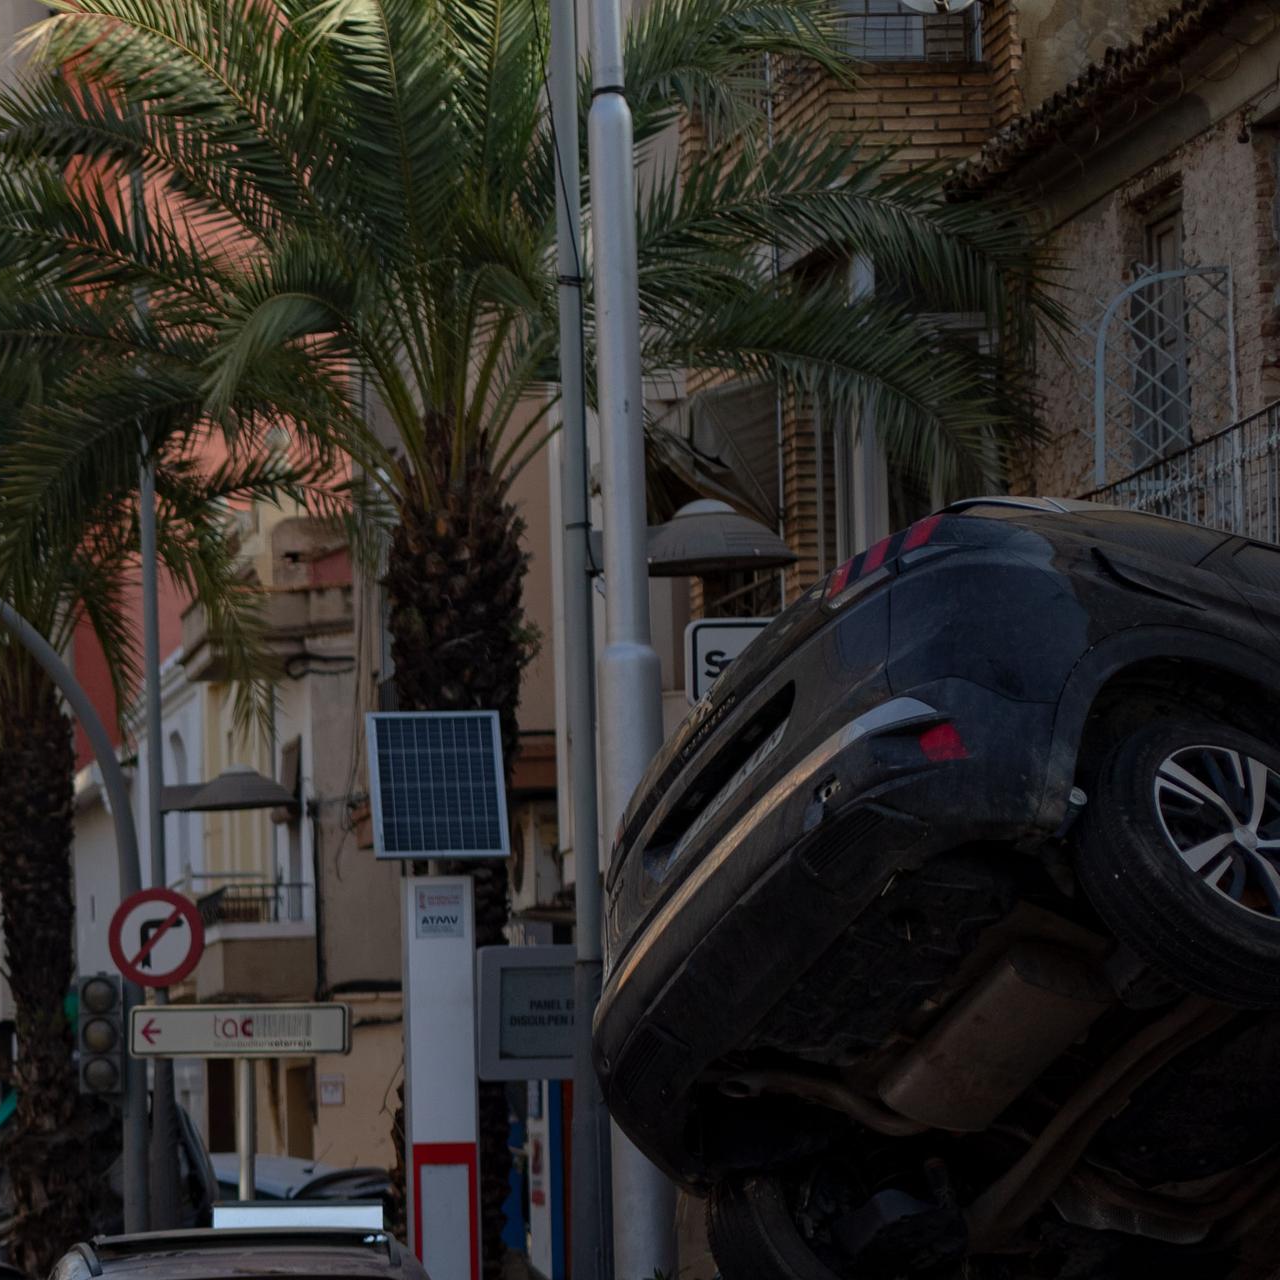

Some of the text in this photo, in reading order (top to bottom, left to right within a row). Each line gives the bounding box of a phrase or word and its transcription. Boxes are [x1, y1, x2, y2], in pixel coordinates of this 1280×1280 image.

[422, 915, 458, 925] ATMV
[530, 999, 561, 1010] PANEL
[510, 1015, 568, 1026] DISCULPEN
[213, 1014, 254, 1039] tac
